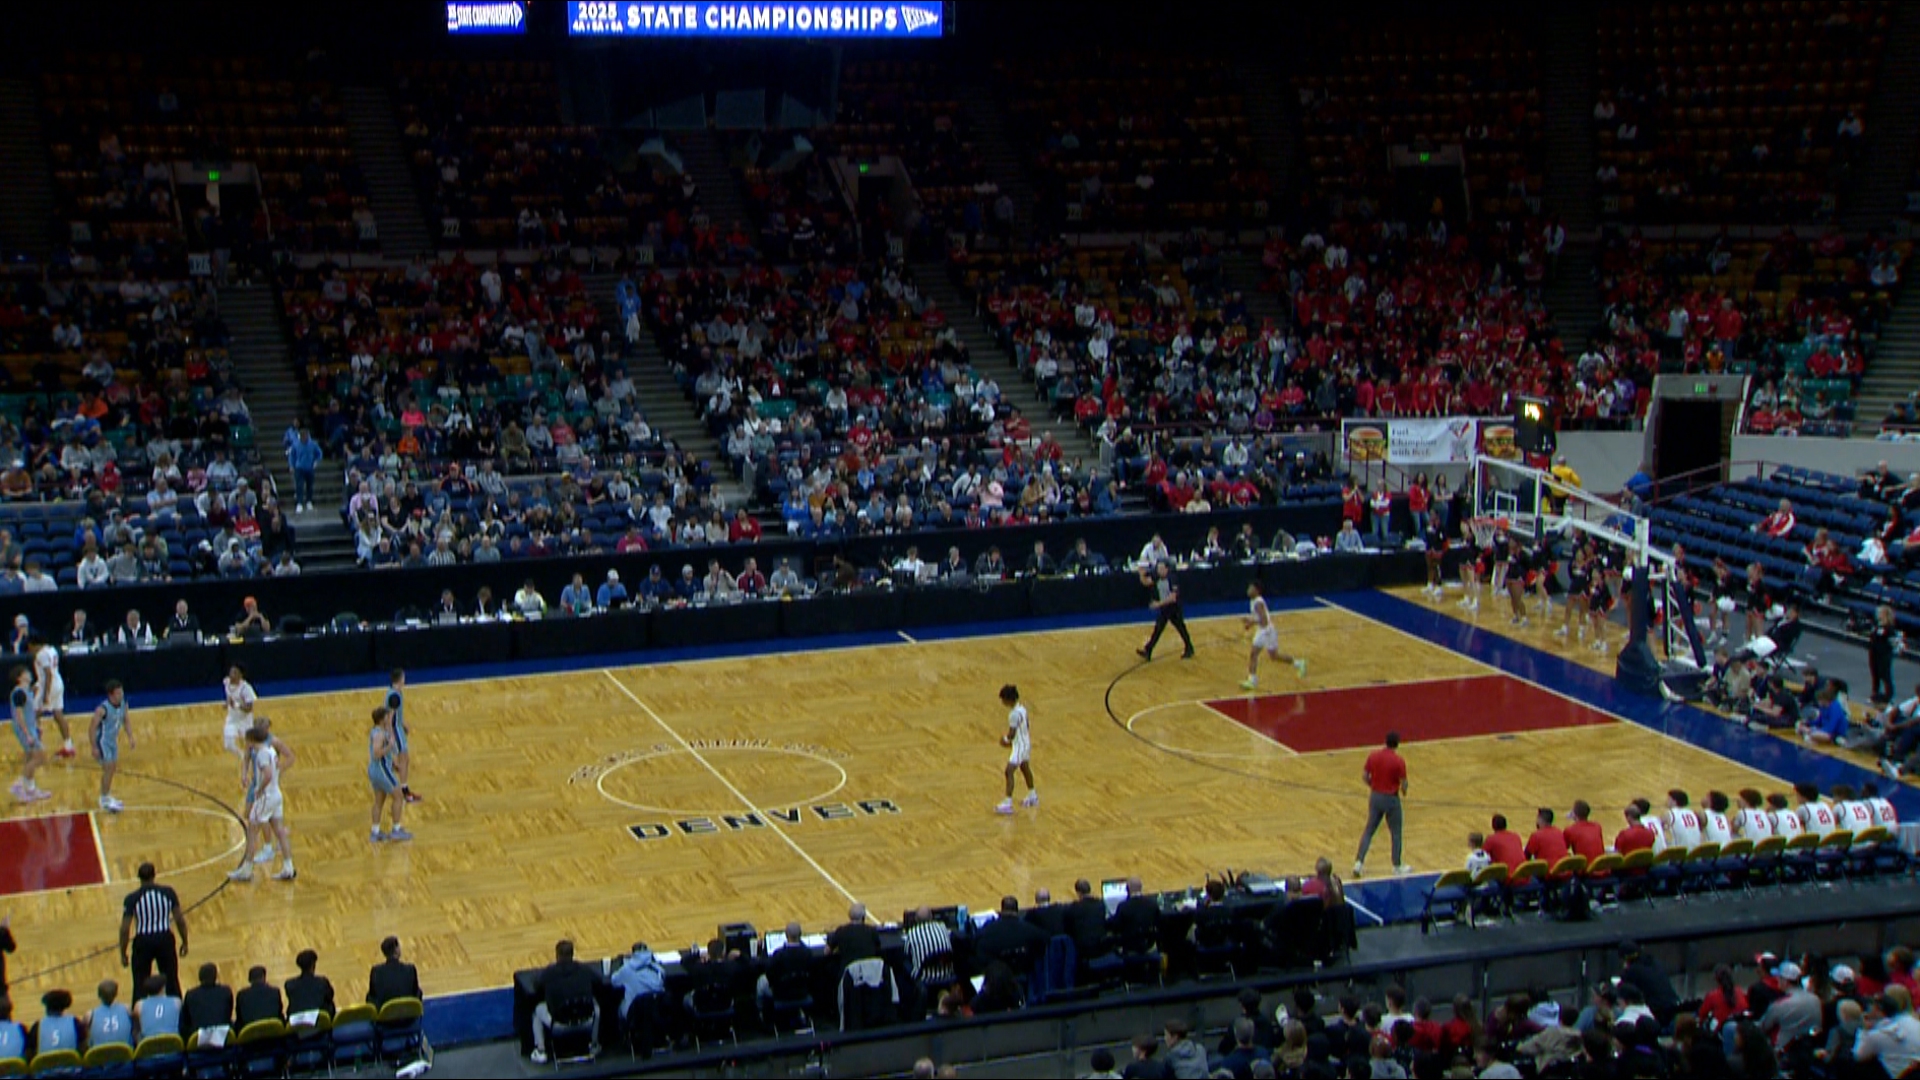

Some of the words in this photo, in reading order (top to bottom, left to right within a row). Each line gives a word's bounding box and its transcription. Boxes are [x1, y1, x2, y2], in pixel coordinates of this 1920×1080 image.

[628, 5, 697, 28] STATE
[705, 6, 897, 30] CHAMPIONSHIPS
[628, 798, 901, 841] DENVER
[1681, 813, 1696, 828] 10
[1715, 815, 1726, 831] 2
